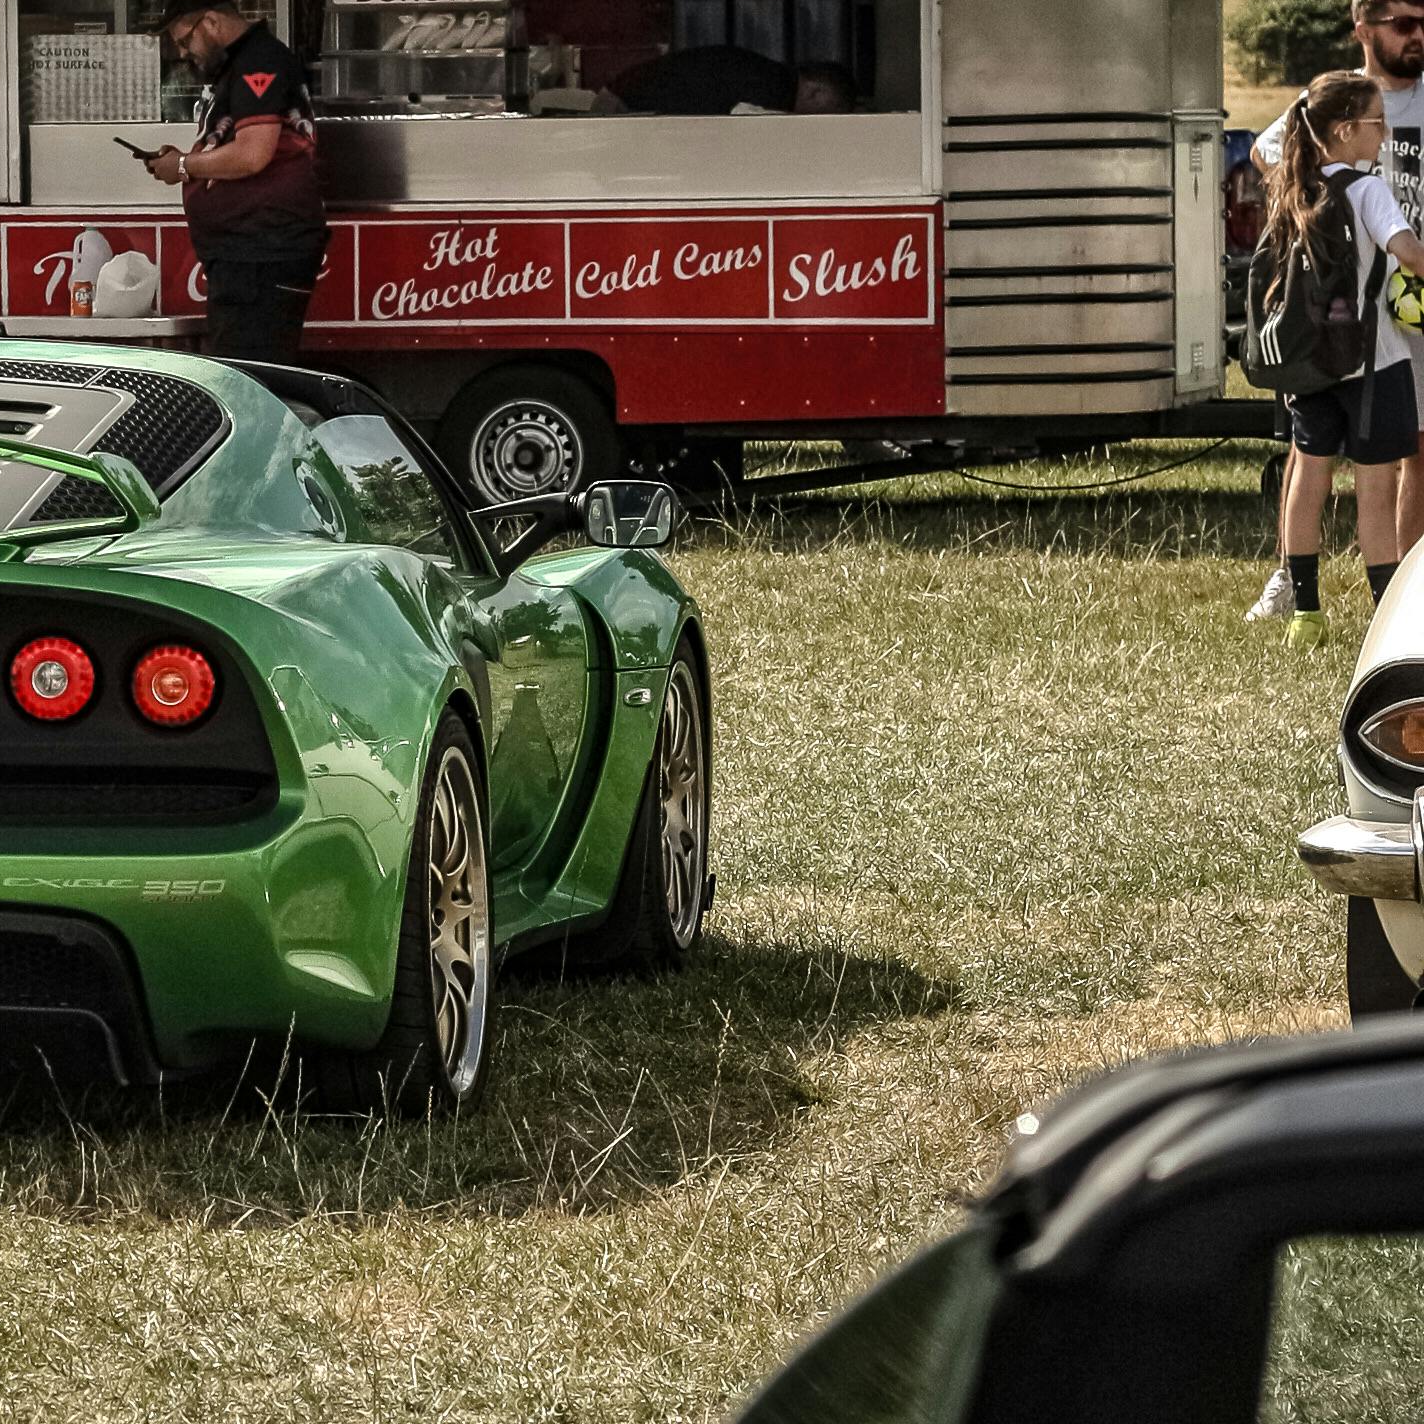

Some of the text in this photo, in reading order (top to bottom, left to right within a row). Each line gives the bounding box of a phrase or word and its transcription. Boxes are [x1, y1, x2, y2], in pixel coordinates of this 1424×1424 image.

[39, 47, 90, 57] CAUTION
[55, 60, 106, 70] SURFACE
[424, 226, 499, 271] Hot
[575, 242, 763, 300] Cold Cans
[782, 234, 922, 303] Slush
[371, 262, 554, 321] Chocolate
[142, 879, 226, 895] 350
